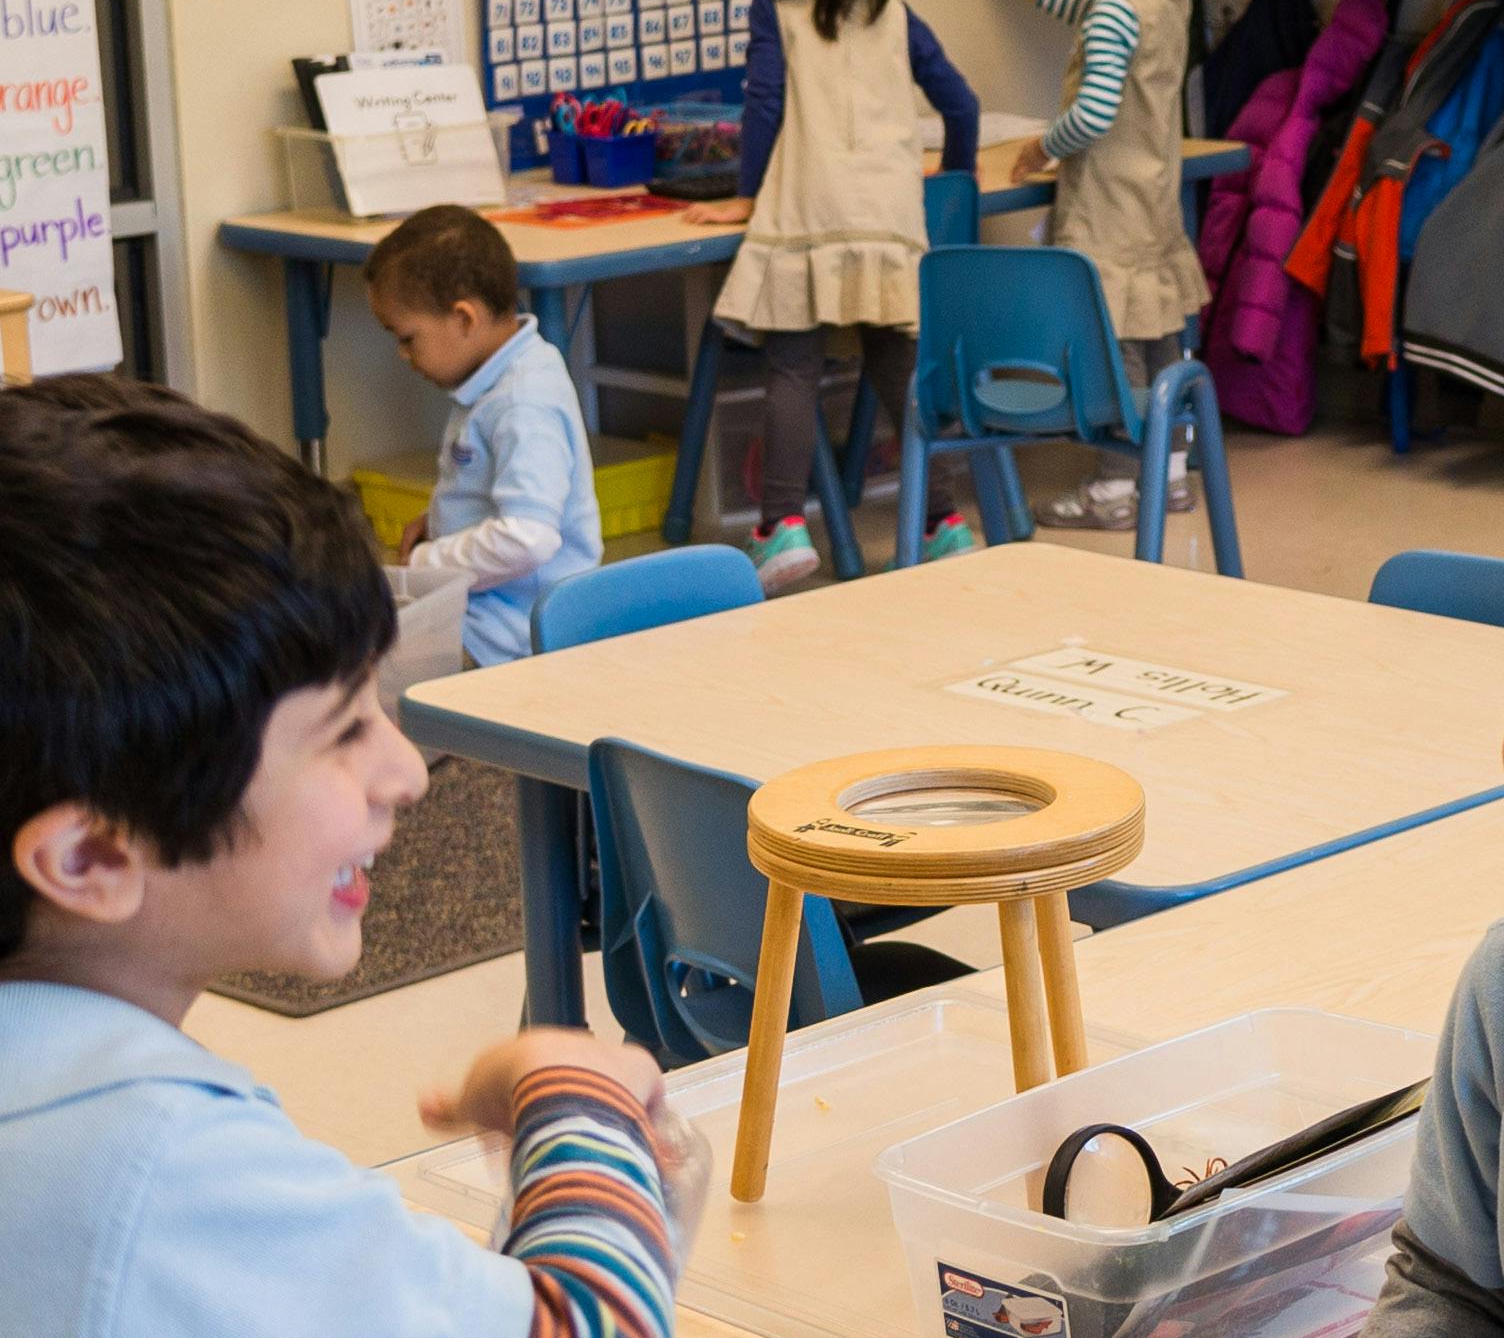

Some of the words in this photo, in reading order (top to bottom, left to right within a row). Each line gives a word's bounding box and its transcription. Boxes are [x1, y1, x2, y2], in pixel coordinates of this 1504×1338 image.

[27, 285, 110, 323] own.
[976, 675, 1096, 711] Quinn
[1114, 705, 1161, 724] C
